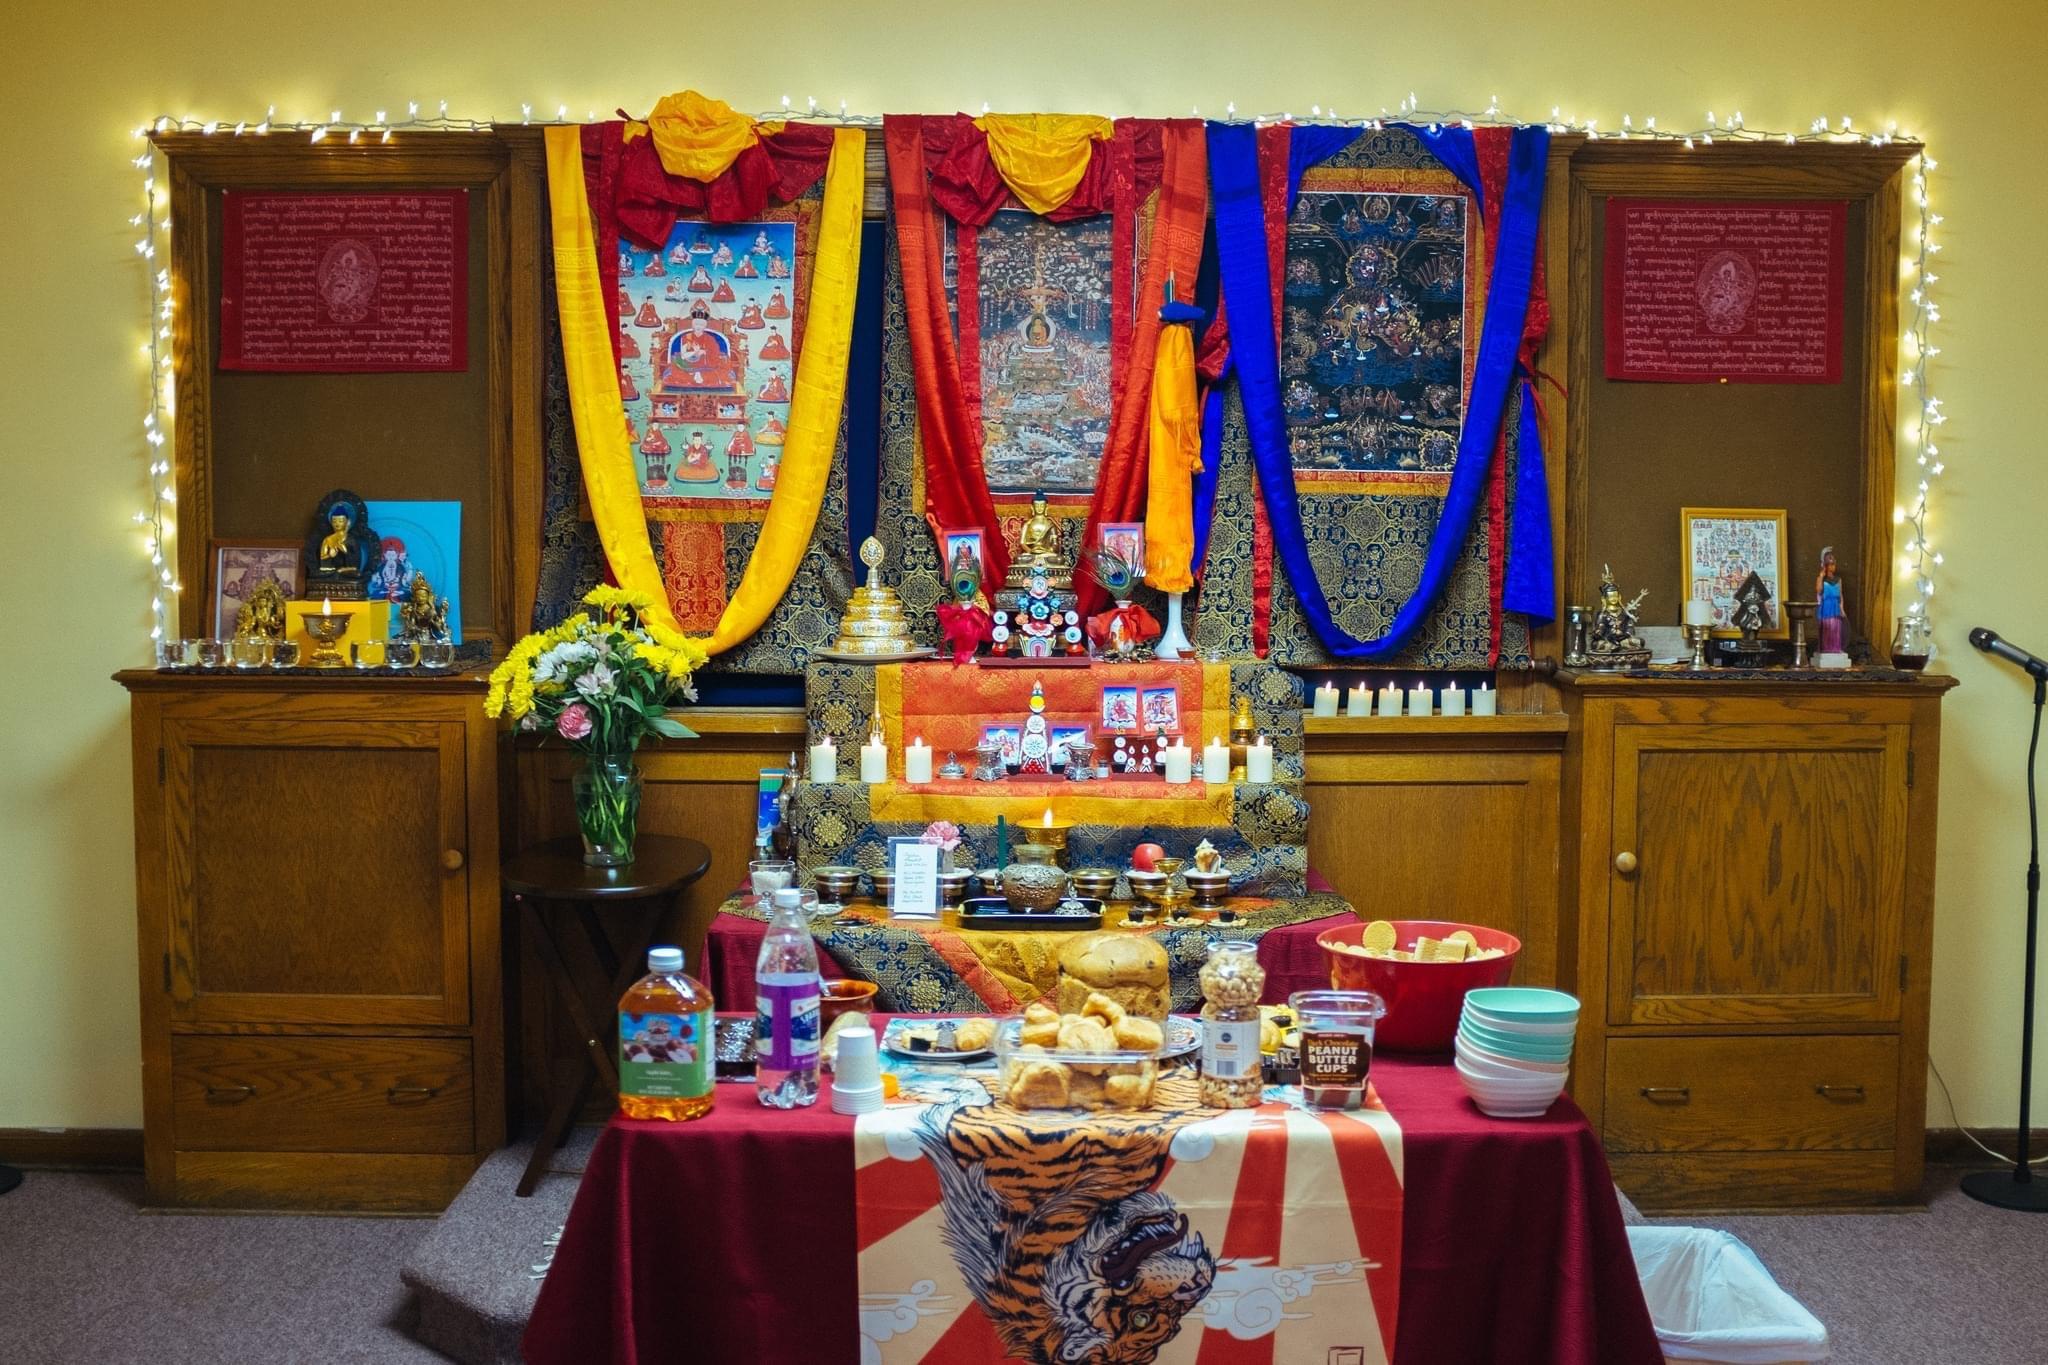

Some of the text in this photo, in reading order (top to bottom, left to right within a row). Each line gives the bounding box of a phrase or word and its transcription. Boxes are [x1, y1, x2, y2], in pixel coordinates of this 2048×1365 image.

[1308, 1046, 1358, 1055] PEANUT
[1309, 1055, 1357, 1064] BUTTER
[1316, 1064, 1348, 1073] CUPS
